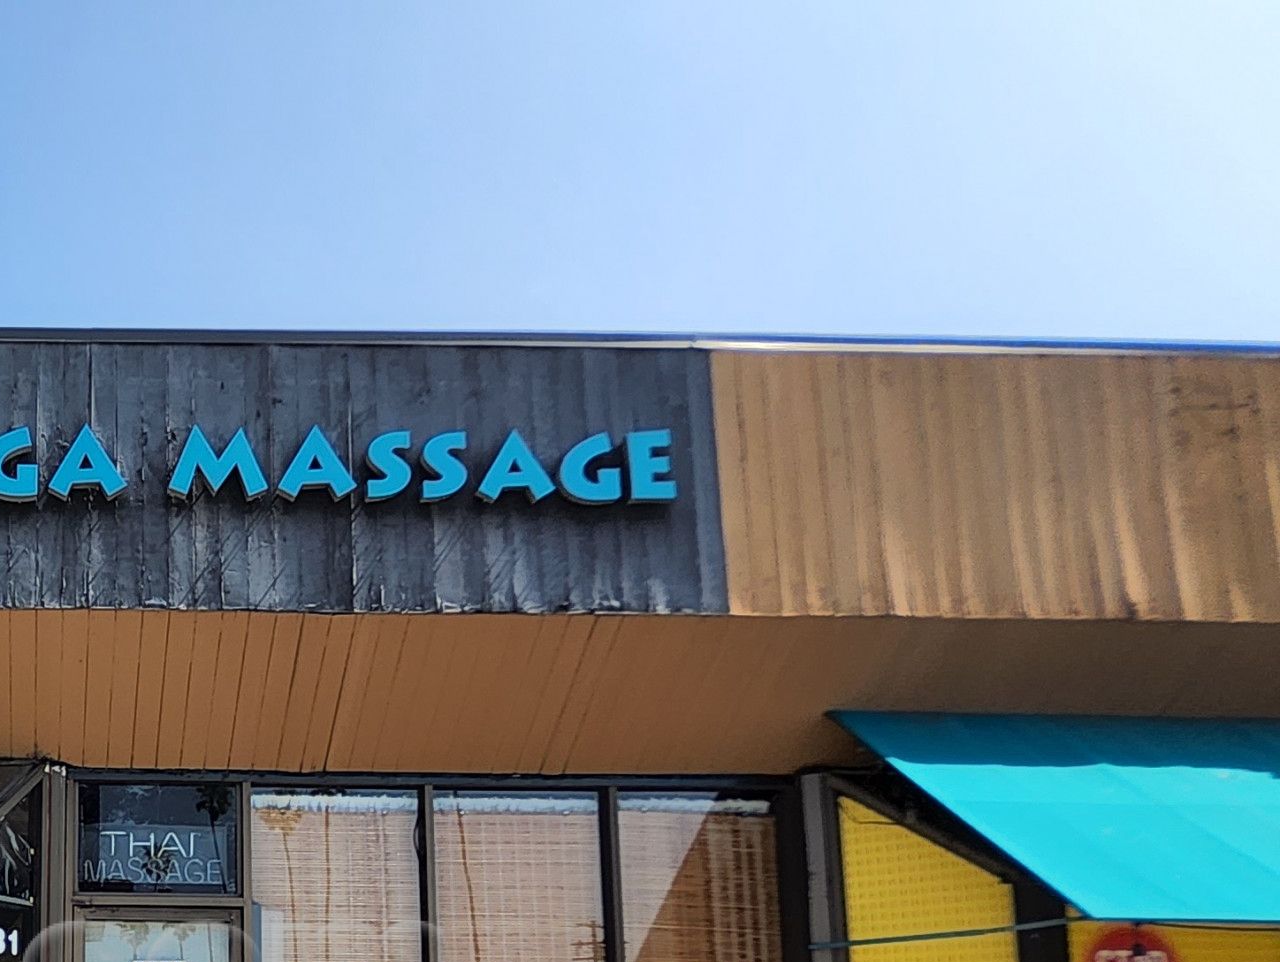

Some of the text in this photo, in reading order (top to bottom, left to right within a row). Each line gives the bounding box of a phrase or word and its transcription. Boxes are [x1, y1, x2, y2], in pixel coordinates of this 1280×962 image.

[167, 424, 678, 504] MASSAGE
[100, 831, 201, 858] THAI
[84, 858, 223, 884] MASSAGE
